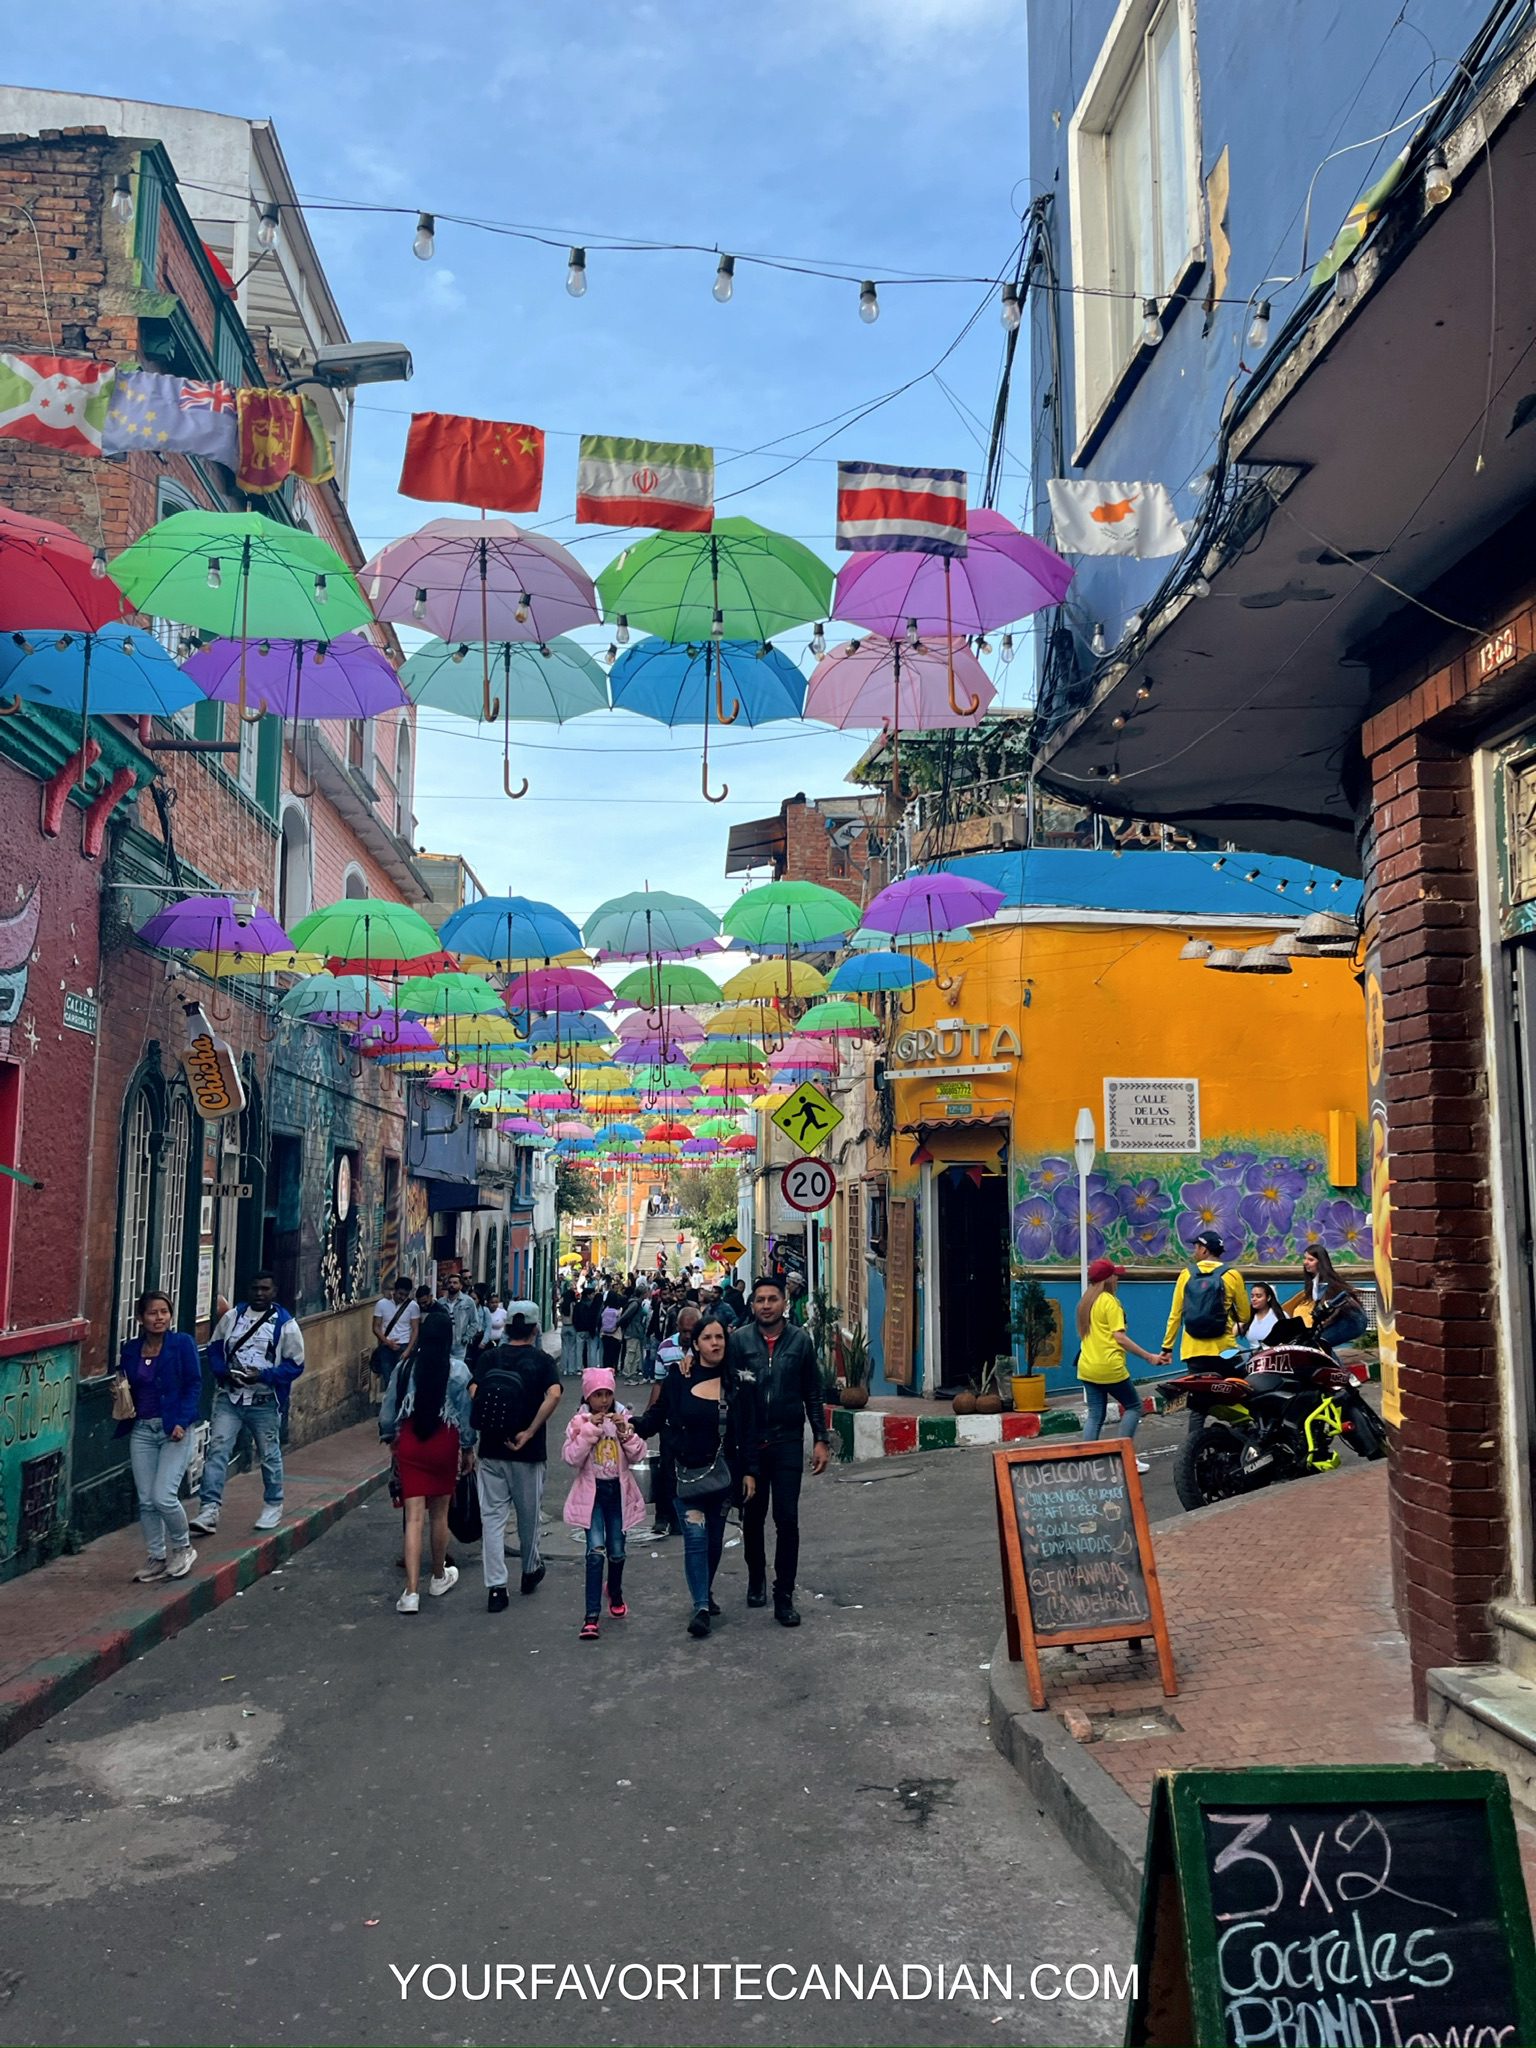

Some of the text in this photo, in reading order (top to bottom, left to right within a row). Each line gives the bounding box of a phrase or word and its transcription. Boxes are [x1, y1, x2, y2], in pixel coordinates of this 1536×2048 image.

[66, 996, 88, 1016] CALLE
[895, 1024, 1022, 1061] GRUTA
[188, 1033, 231, 1110] Chicha
[1134, 1094, 1168, 1104] CALLE
[1129, 1117, 1176, 1126] VIOLETAS
[1134, 1107, 1170, 1117] DE LAS
[792, 1171, 826, 1198] 20
[1041, 1534, 1114, 1557] EMPANADAS
[1029, 1562, 1129, 1597] @EMPANADAS
